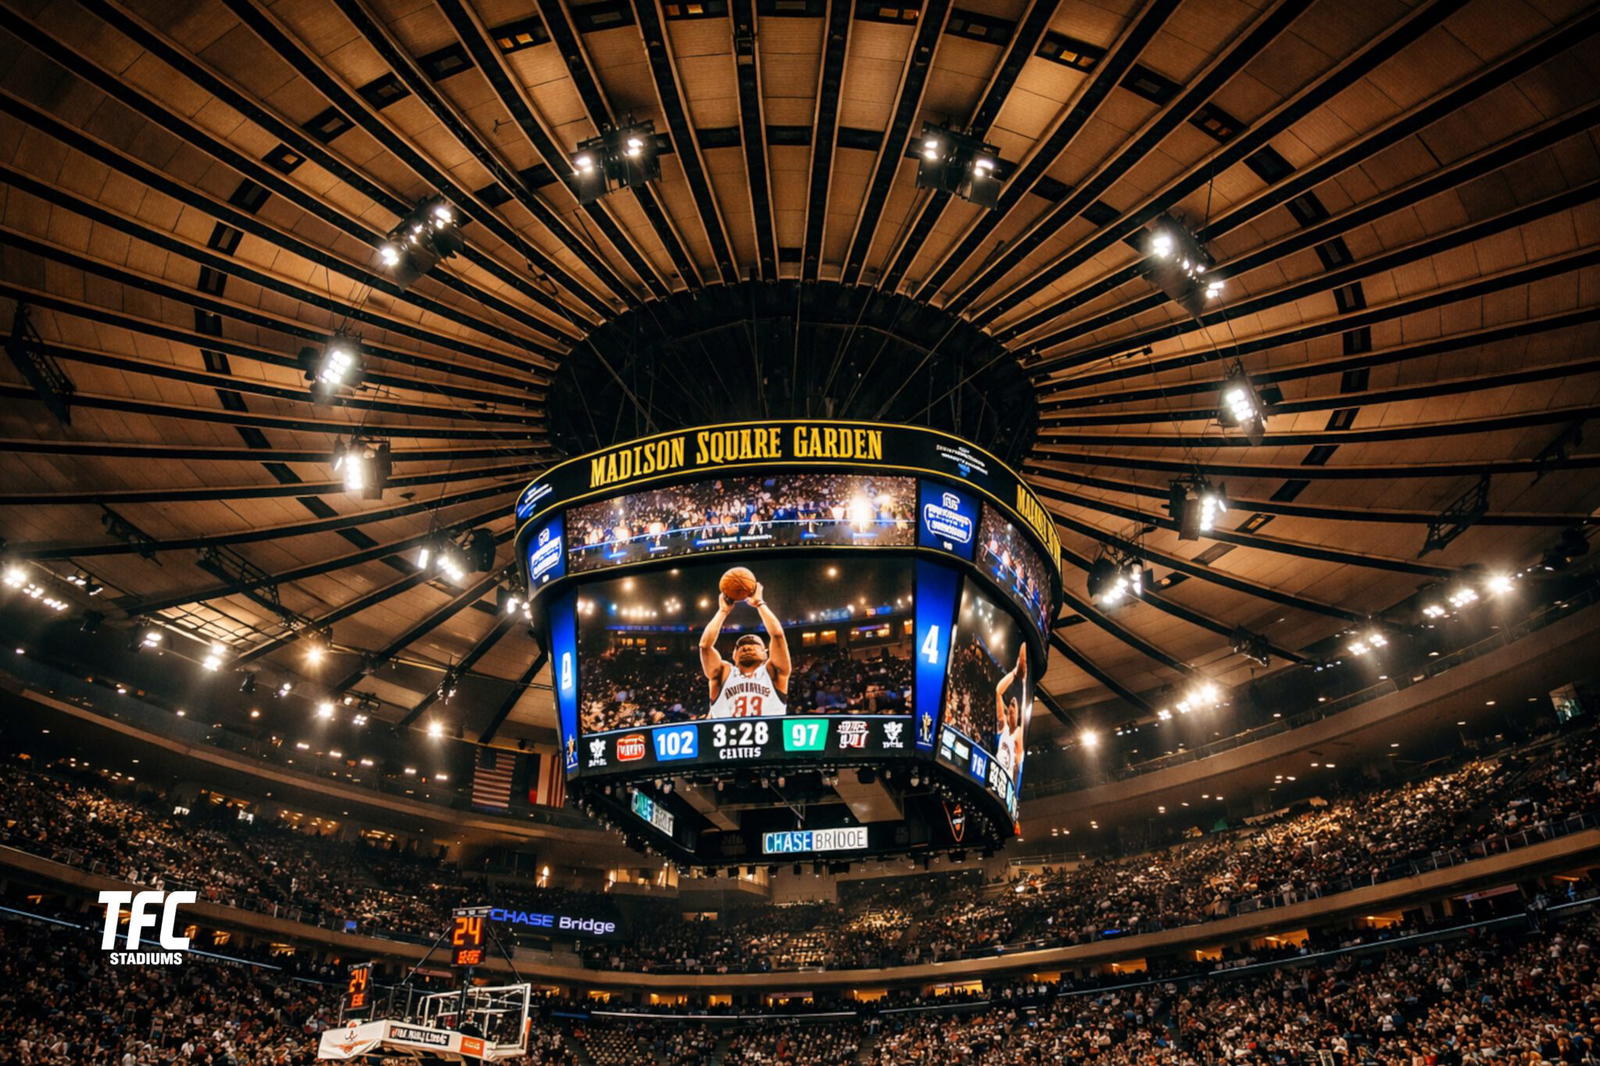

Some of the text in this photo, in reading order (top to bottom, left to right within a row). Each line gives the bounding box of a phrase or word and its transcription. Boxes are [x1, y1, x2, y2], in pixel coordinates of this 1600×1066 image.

[590, 426, 883, 488] MADISON SQUARE GARDEN
[921, 624, 939, 664] 4
[656, 731, 694, 756] 102
[712, 721, 769, 747] 3:28
[792, 724, 819, 747] 97
[765, 832, 812, 854] CHASE
[453, 917, 481, 945] 24
[490, 908, 615, 934] CHASE Bridge
[349, 967, 367, 992] 24
